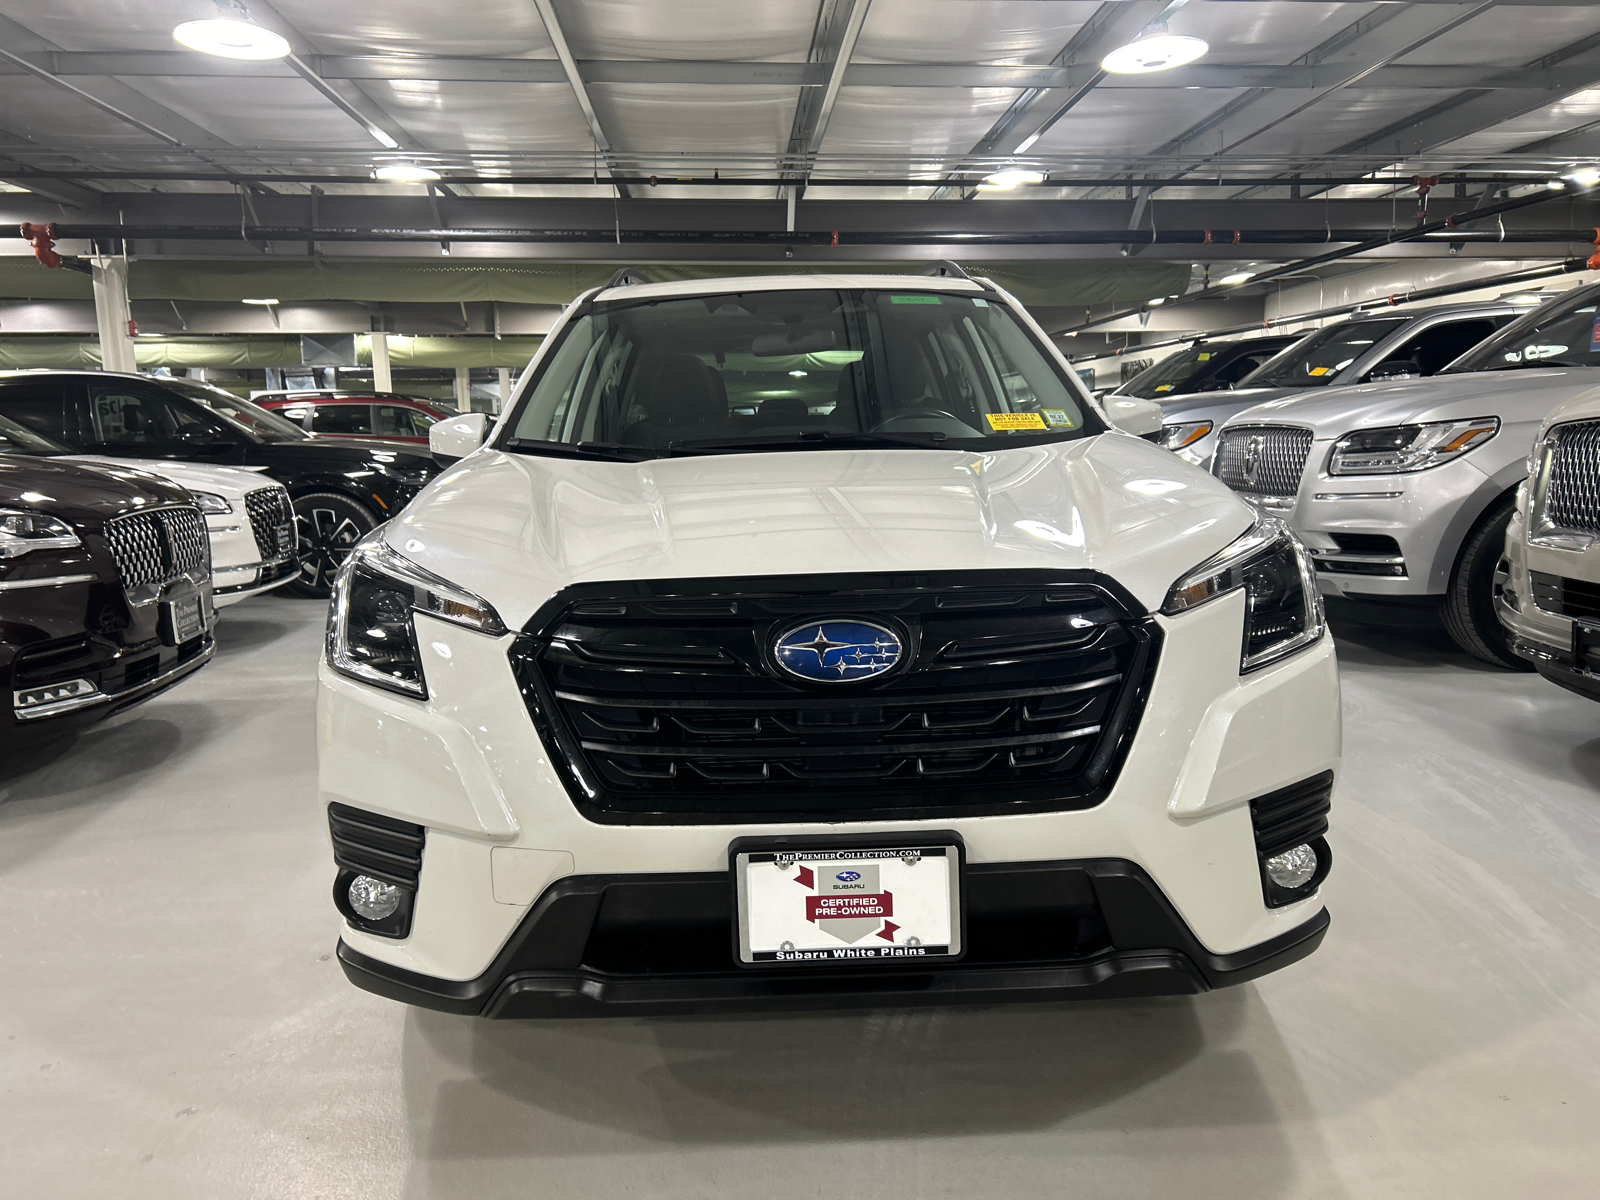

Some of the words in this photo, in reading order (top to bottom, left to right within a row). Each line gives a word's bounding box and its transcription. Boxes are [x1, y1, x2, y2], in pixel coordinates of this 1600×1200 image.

[820, 897, 878, 907] CERTIFIED
[815, 906, 884, 916] PRE-OWNED
[776, 950, 828, 960] Subaru
[832, 948, 876, 959] White
[880, 946, 926, 957] Plains
